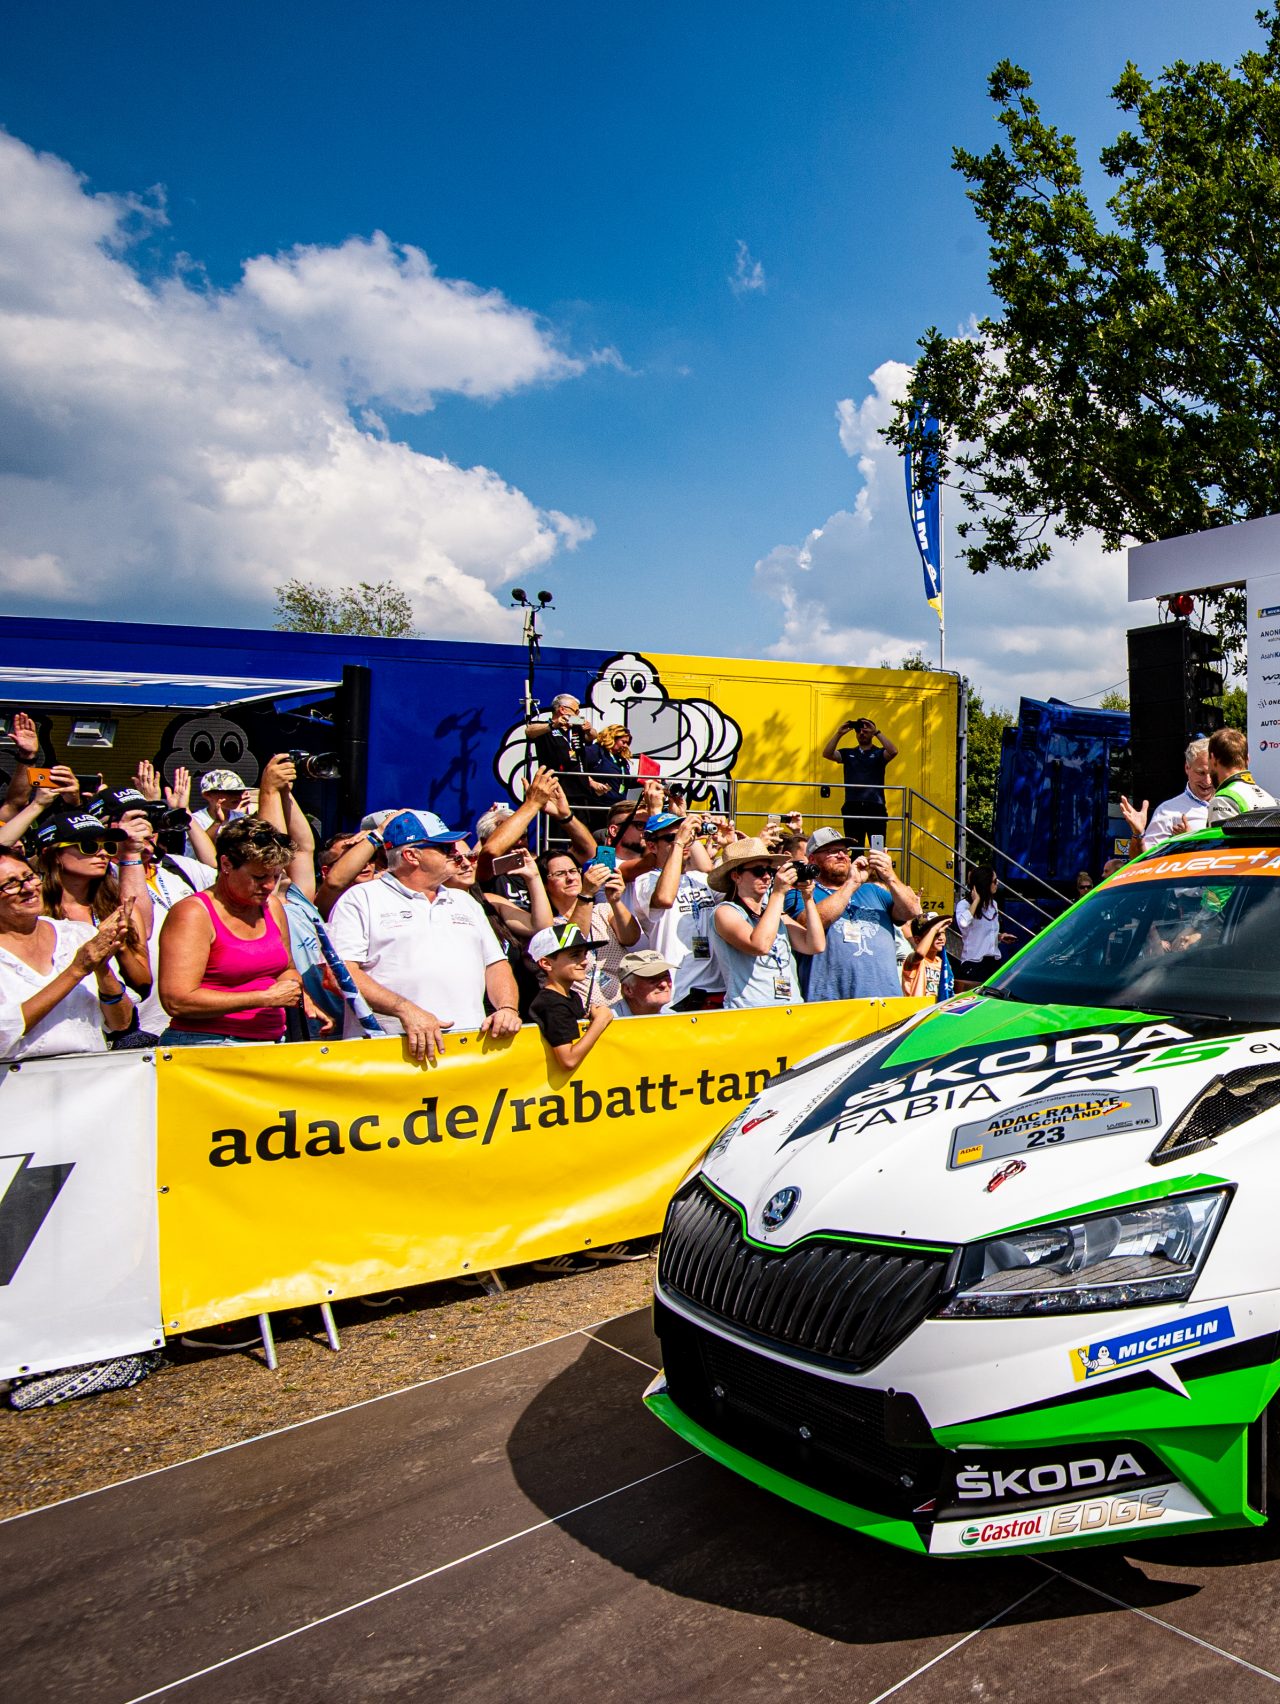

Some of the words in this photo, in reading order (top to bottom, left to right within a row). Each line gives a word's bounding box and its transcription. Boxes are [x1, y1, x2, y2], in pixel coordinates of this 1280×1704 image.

[922, 901, 945, 910] 274
[844, 1023, 1194, 1108] ŠKODA
[827, 1083, 1002, 1144] FABIA
[1019, 1036, 1245, 1097] R5
[987, 1112, 1040, 1131] ADAC
[1046, 1096, 1120, 1118] RALLYE
[993, 1109, 1101, 1137] DEUTSCHLAND
[960, 1145, 982, 1155] ADAC
[1026, 1126, 1065, 1148] 23
[1118, 1320, 1219, 1361] MICHELIN
[956, 1453, 1146, 1500] ŠKODA
[979, 1515, 1042, 1543] Castrol
[1049, 1489, 1169, 1537] EDGE
